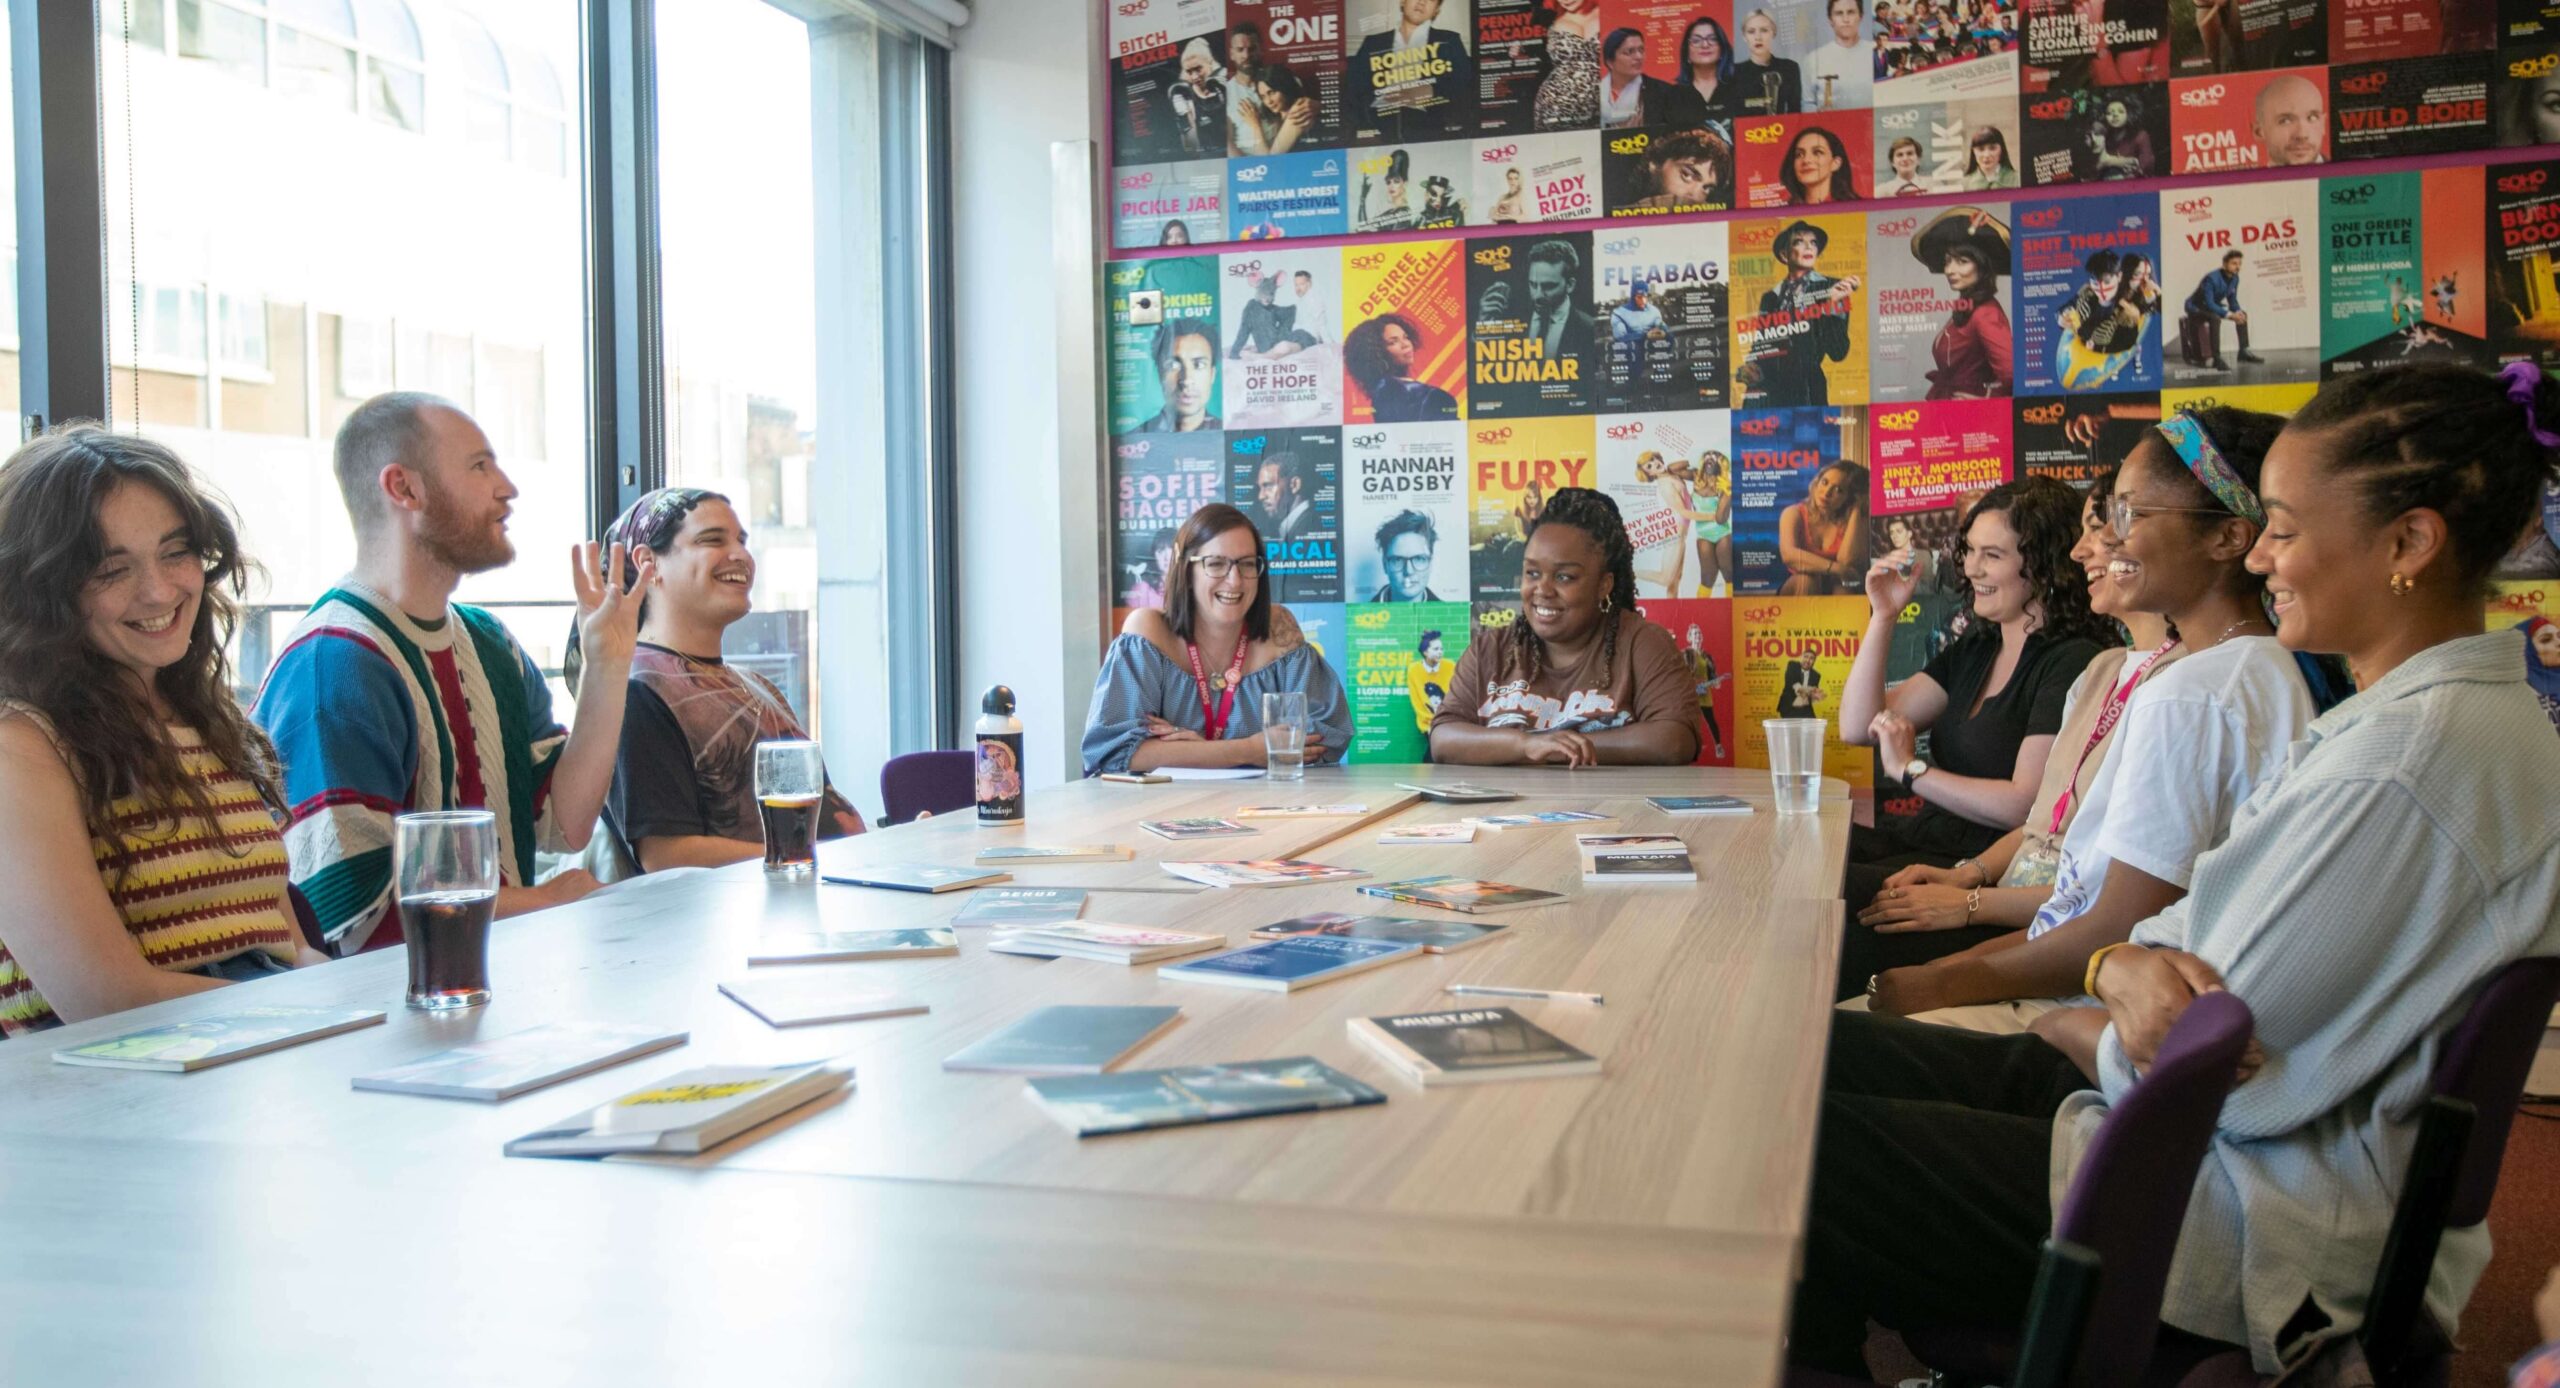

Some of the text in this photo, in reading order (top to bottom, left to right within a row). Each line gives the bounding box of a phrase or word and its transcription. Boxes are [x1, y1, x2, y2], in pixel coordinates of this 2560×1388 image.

[1268, 5, 1295, 18] THE
[2029, 13, 2089, 29] ARTHUR
[1269, 14, 1339, 45] ONE
[1479, 13, 1533, 31] PENNY
[2028, 19, 2127, 41] SMITH SINGS
[1119, 30, 1168, 54] BITCH
[1480, 25, 1548, 43] ARCADE:
[2028, 28, 2158, 51] LEONARD COHEN
[1121, 43, 1179, 70] BOXER
[1369, 42, 1440, 72] RONNY
[2508, 54, 2559, 78] SOHO
[1372, 58, 1453, 88] CHIENG:
[2340, 71, 2387, 94] SOHO
[2180, 84, 2225, 106] SOHO
[1881, 110, 1919, 129] SOHO
[2339, 99, 2487, 131] WILD BORE
[1744, 123, 1785, 143] SOHO
[2182, 129, 2237, 153] TOM
[1610, 133, 1649, 154] SOHO
[1481, 144, 1518, 164] SOHO
[2185, 146, 2259, 172] ALLEN
[1120, 172, 1153, 189] SOHO
[1236, 164, 1268, 181] SOHO
[2497, 169, 2547, 192] SOHO
[1237, 185, 1340, 203] WALTHAM FOREST
[1535, 174, 1585, 202] LADY
[2330, 183, 2375, 204] SOHO
[1186, 196, 1220, 212] JAR
[1238, 196, 1340, 214] PARKS FESTIVAL
[1538, 193, 1592, 216] RIZO:
[1542, 206, 1592, 222] MULTIPLIED
[2174, 196, 2212, 214] SOHO
[1877, 217, 1917, 236] SOHO
[2186, 218, 2297, 252] VIR DAS
[2331, 217, 2412, 233] ONE GREEN
[1603, 237, 1641, 255] SOHO
[2265, 239, 2298, 251] LOVED
[2332, 230, 2411, 249] BOTTLE
[1351, 252, 1385, 269] SOHO
[1474, 245, 1512, 265] SOHO
[1228, 259, 1262, 277] SOHO
[1604, 261, 1719, 286] FLEABAG
[1359, 251, 1417, 316] DESIREE
[1387, 250, 1438, 308] BURCH
[1879, 288, 1934, 302] SHAPPI
[1184, 306, 1213, 318] GUY
[1879, 298, 1973, 315] KHORSANDI
[1736, 310, 1791, 334] DAVID
[1879, 314, 1927, 324] MISTRESS
[1879, 322, 1938, 334] AND MISFIT
[1738, 320, 1810, 345] DIAMOND
[1475, 337, 1544, 361] NISH
[1246, 363, 1297, 375] THE END
[1476, 358, 1580, 385] KUMAR
[1246, 374, 1317, 390] OF HOPE
[1246, 394, 1317, 404] DAVID IRELAND
[1879, 409, 1919, 430] SOHO
[2023, 402, 2065, 423] SOHO
[1476, 426, 1512, 444] SOHO
[1607, 421, 1643, 439] SOHO
[1740, 415, 1779, 435] SOHO
[1117, 440, 1150, 457] SOHO
[1232, 435, 1267, 454] SOHO
[1352, 432, 1387, 449] SOHO
[1362, 456, 1455, 475] HANNAH
[1741, 449, 1819, 470] TOUCH
[1883, 457, 2001, 480] JINKX MONSOON
[1362, 474, 1455, 493] GADSBY
[1477, 458, 1588, 492] FURY
[1899, 474, 1945, 488] MAJOR
[1951, 468, 2003, 483] SCALES:
[1119, 473, 1217, 500] SOFIE
[1884, 478, 2003, 500] THE VAUDEVILLIANS
[1119, 498, 1209, 519] HAGEN
[1645, 508, 1672, 523] WOO
[1631, 524, 1678, 549] OCOLAT
[1634, 516, 1676, 538] GATEAU
[1265, 540, 1337, 561] PICAL
[1269, 559, 1337, 569] CALAIS CAMERON
[1479, 608, 1516, 628] SOHO
[1744, 605, 1781, 621] SOHO
[1786, 629, 1843, 637] SWALLOW
[1744, 638, 1860, 658] HOUDINI
[1357, 651, 1414, 668] JESSIE
[1188, 645, 1210, 705] SOHO THEATRE
[1356, 669, 1408, 686] CAVE
[1361, 687, 1391, 696] LOVED
[2097, 698, 2125, 737] SOHO
[1391, 1010, 1504, 1028] MUSTAFA
